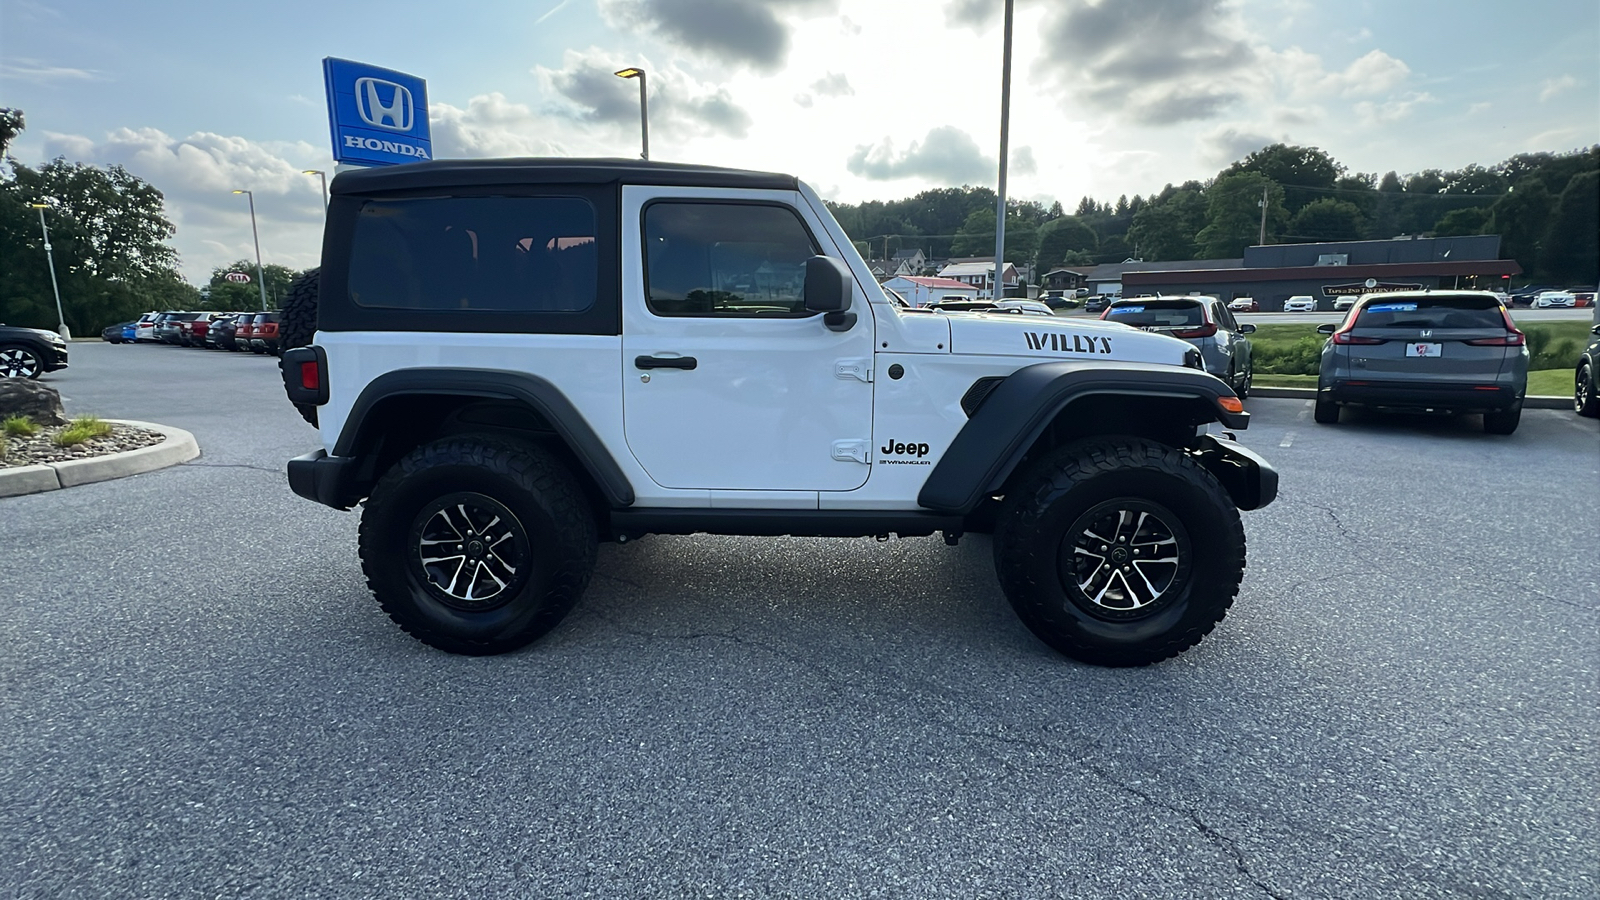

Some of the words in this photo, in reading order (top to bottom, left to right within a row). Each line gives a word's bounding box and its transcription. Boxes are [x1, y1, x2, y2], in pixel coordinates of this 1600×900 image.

[343, 135, 431, 160] HONDA
[1023, 331, 1112, 354] WILLYS
[881, 439, 930, 458] Jeep
